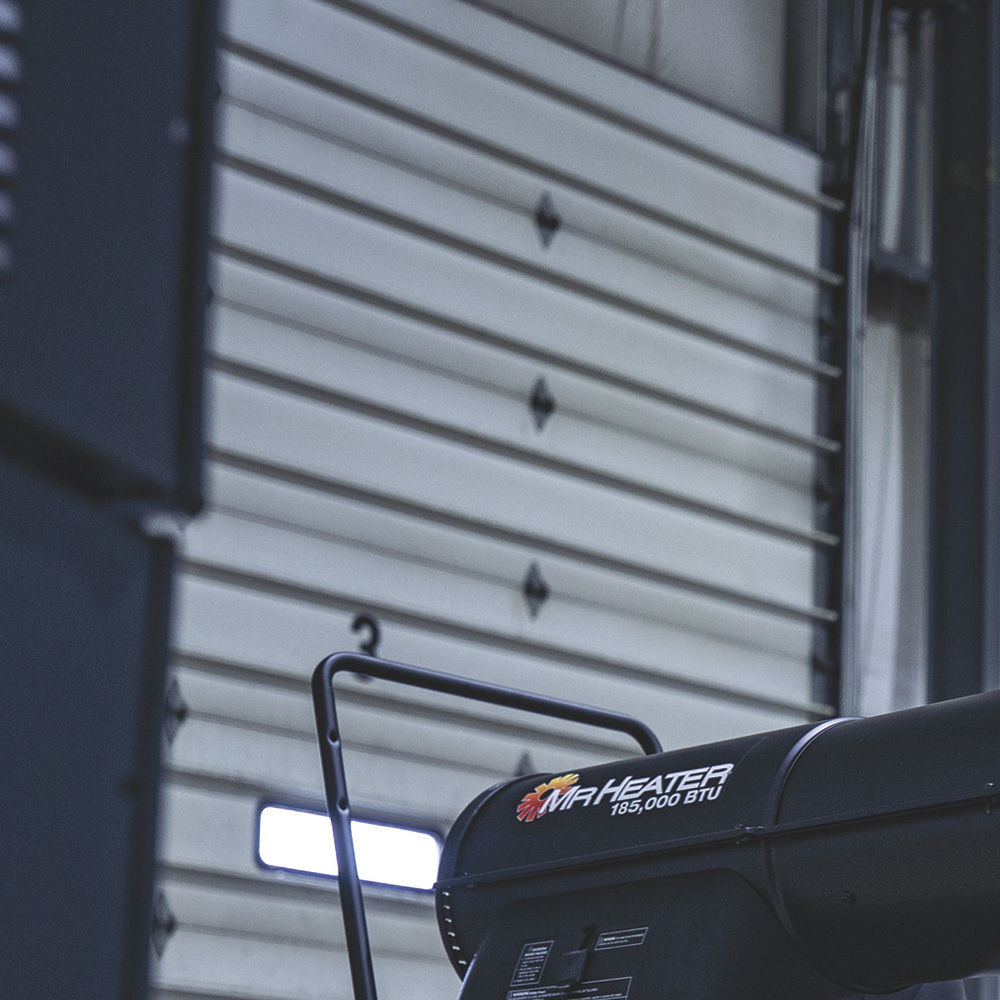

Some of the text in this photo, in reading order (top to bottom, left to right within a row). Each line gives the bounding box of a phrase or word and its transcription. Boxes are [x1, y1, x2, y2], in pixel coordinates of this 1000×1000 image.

[594, 763, 735, 805] HEATER
[611, 786, 723, 816] 185,000 BTU
